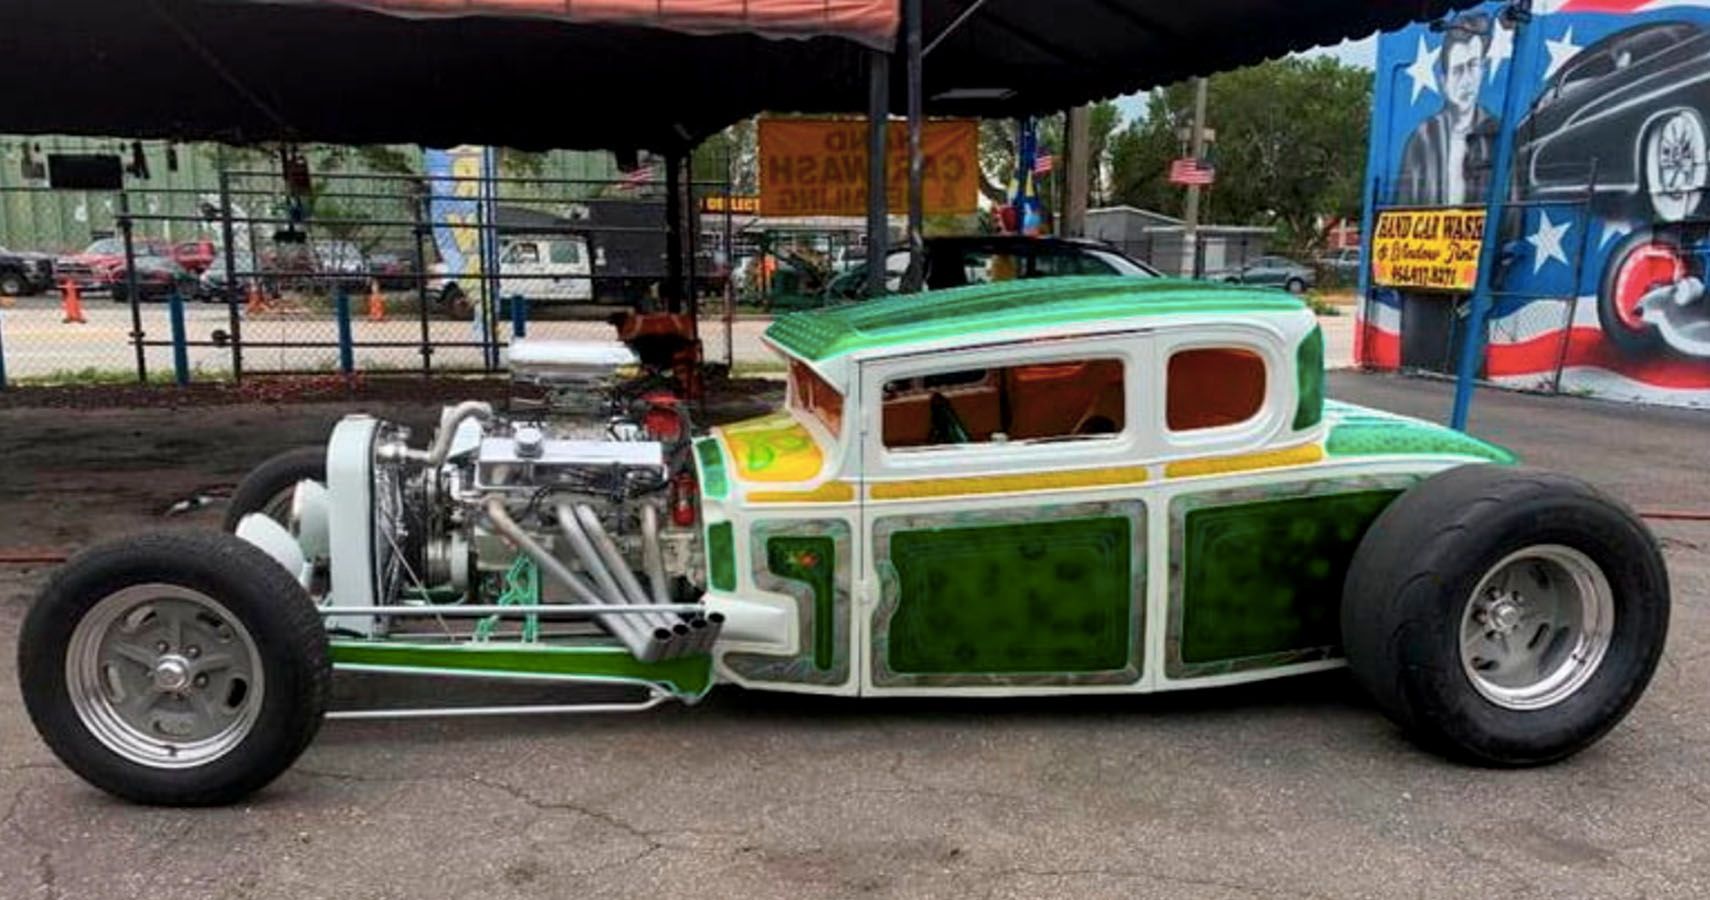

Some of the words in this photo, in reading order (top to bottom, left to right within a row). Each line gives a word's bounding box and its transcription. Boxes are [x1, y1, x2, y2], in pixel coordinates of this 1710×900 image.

[1377, 215, 1412, 239] HAND
[1412, 215, 1440, 239] CAR
[1443, 215, 1484, 240] WASH
[1390, 240, 1440, 262] Window
